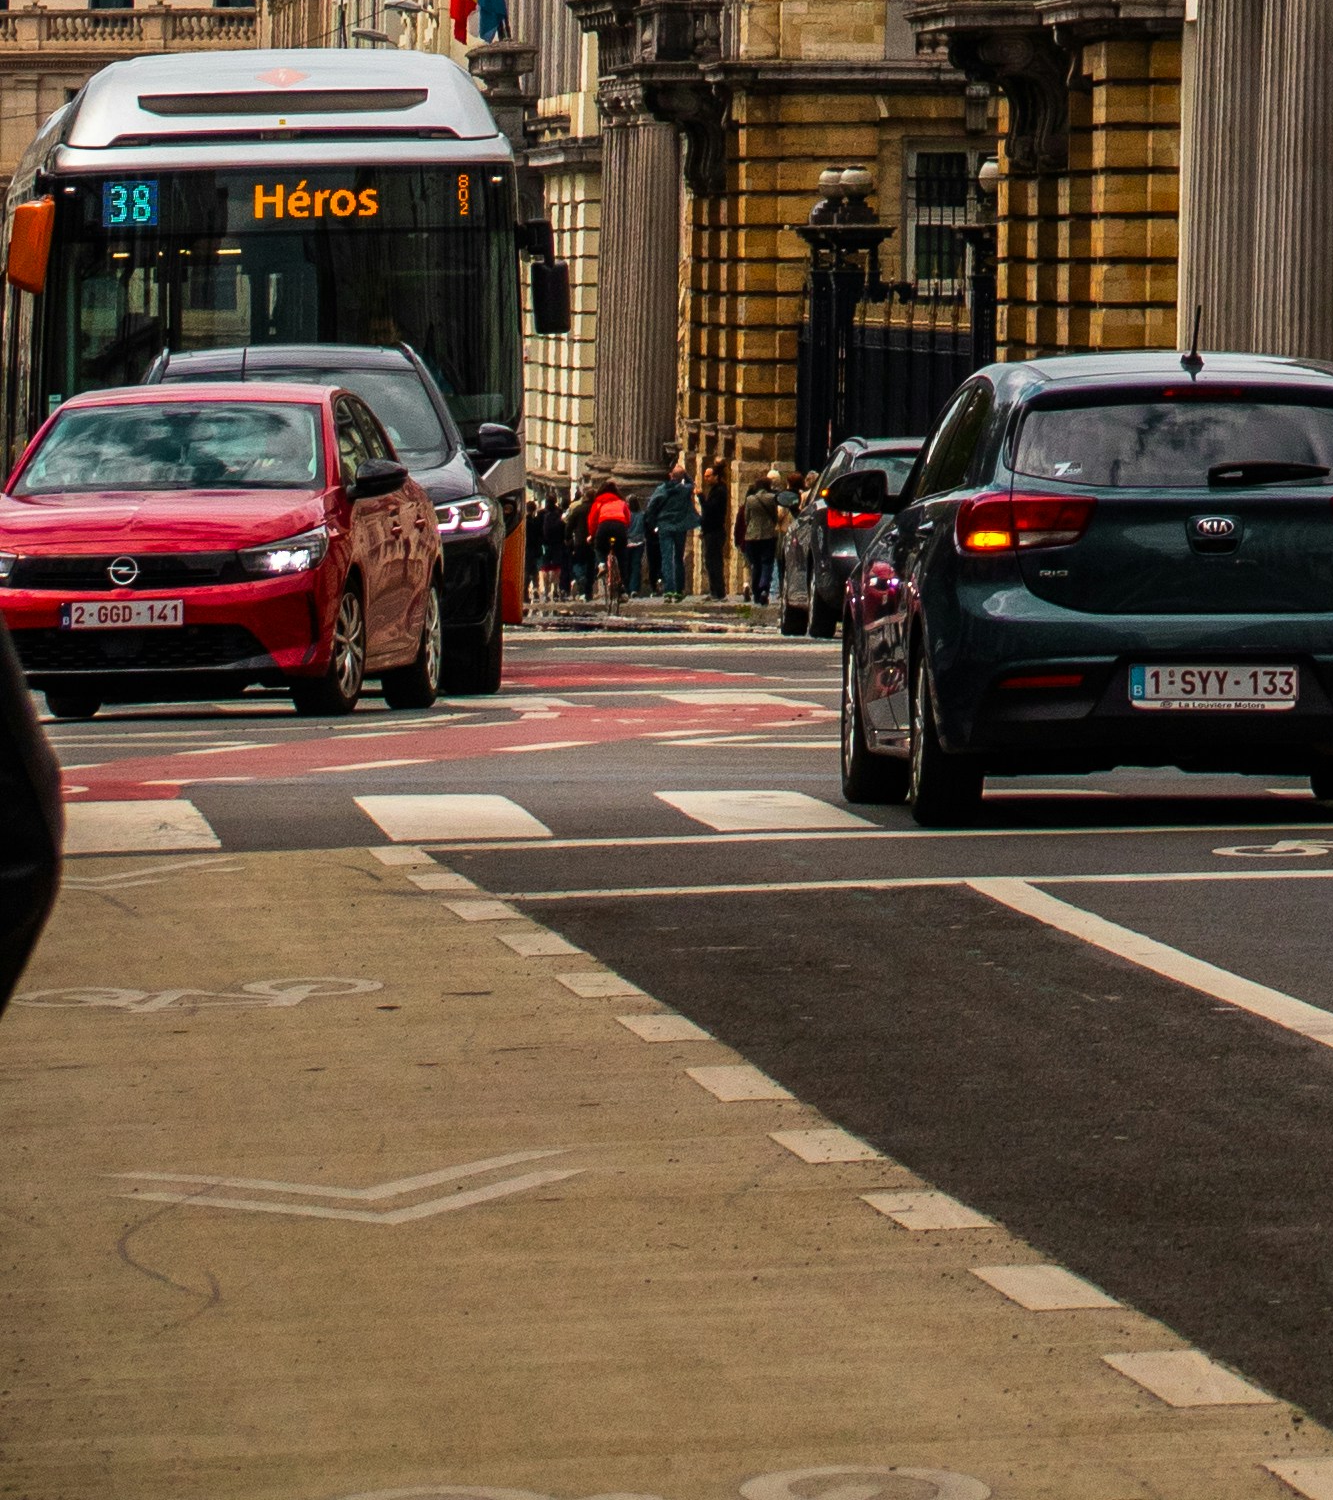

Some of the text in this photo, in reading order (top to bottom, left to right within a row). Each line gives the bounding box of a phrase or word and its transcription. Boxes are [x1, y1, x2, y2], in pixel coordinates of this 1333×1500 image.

[109, 174, 469, 223] 38 Héros 802
[1202, 521, 1228, 533] KIA
[74, 603, 179, 625] 2-GGD-141
[1133, 670, 1295, 696] B 1-SYY-133
[1178, 701, 1190, 709] La
[1234, 701, 1266, 709] Motors
